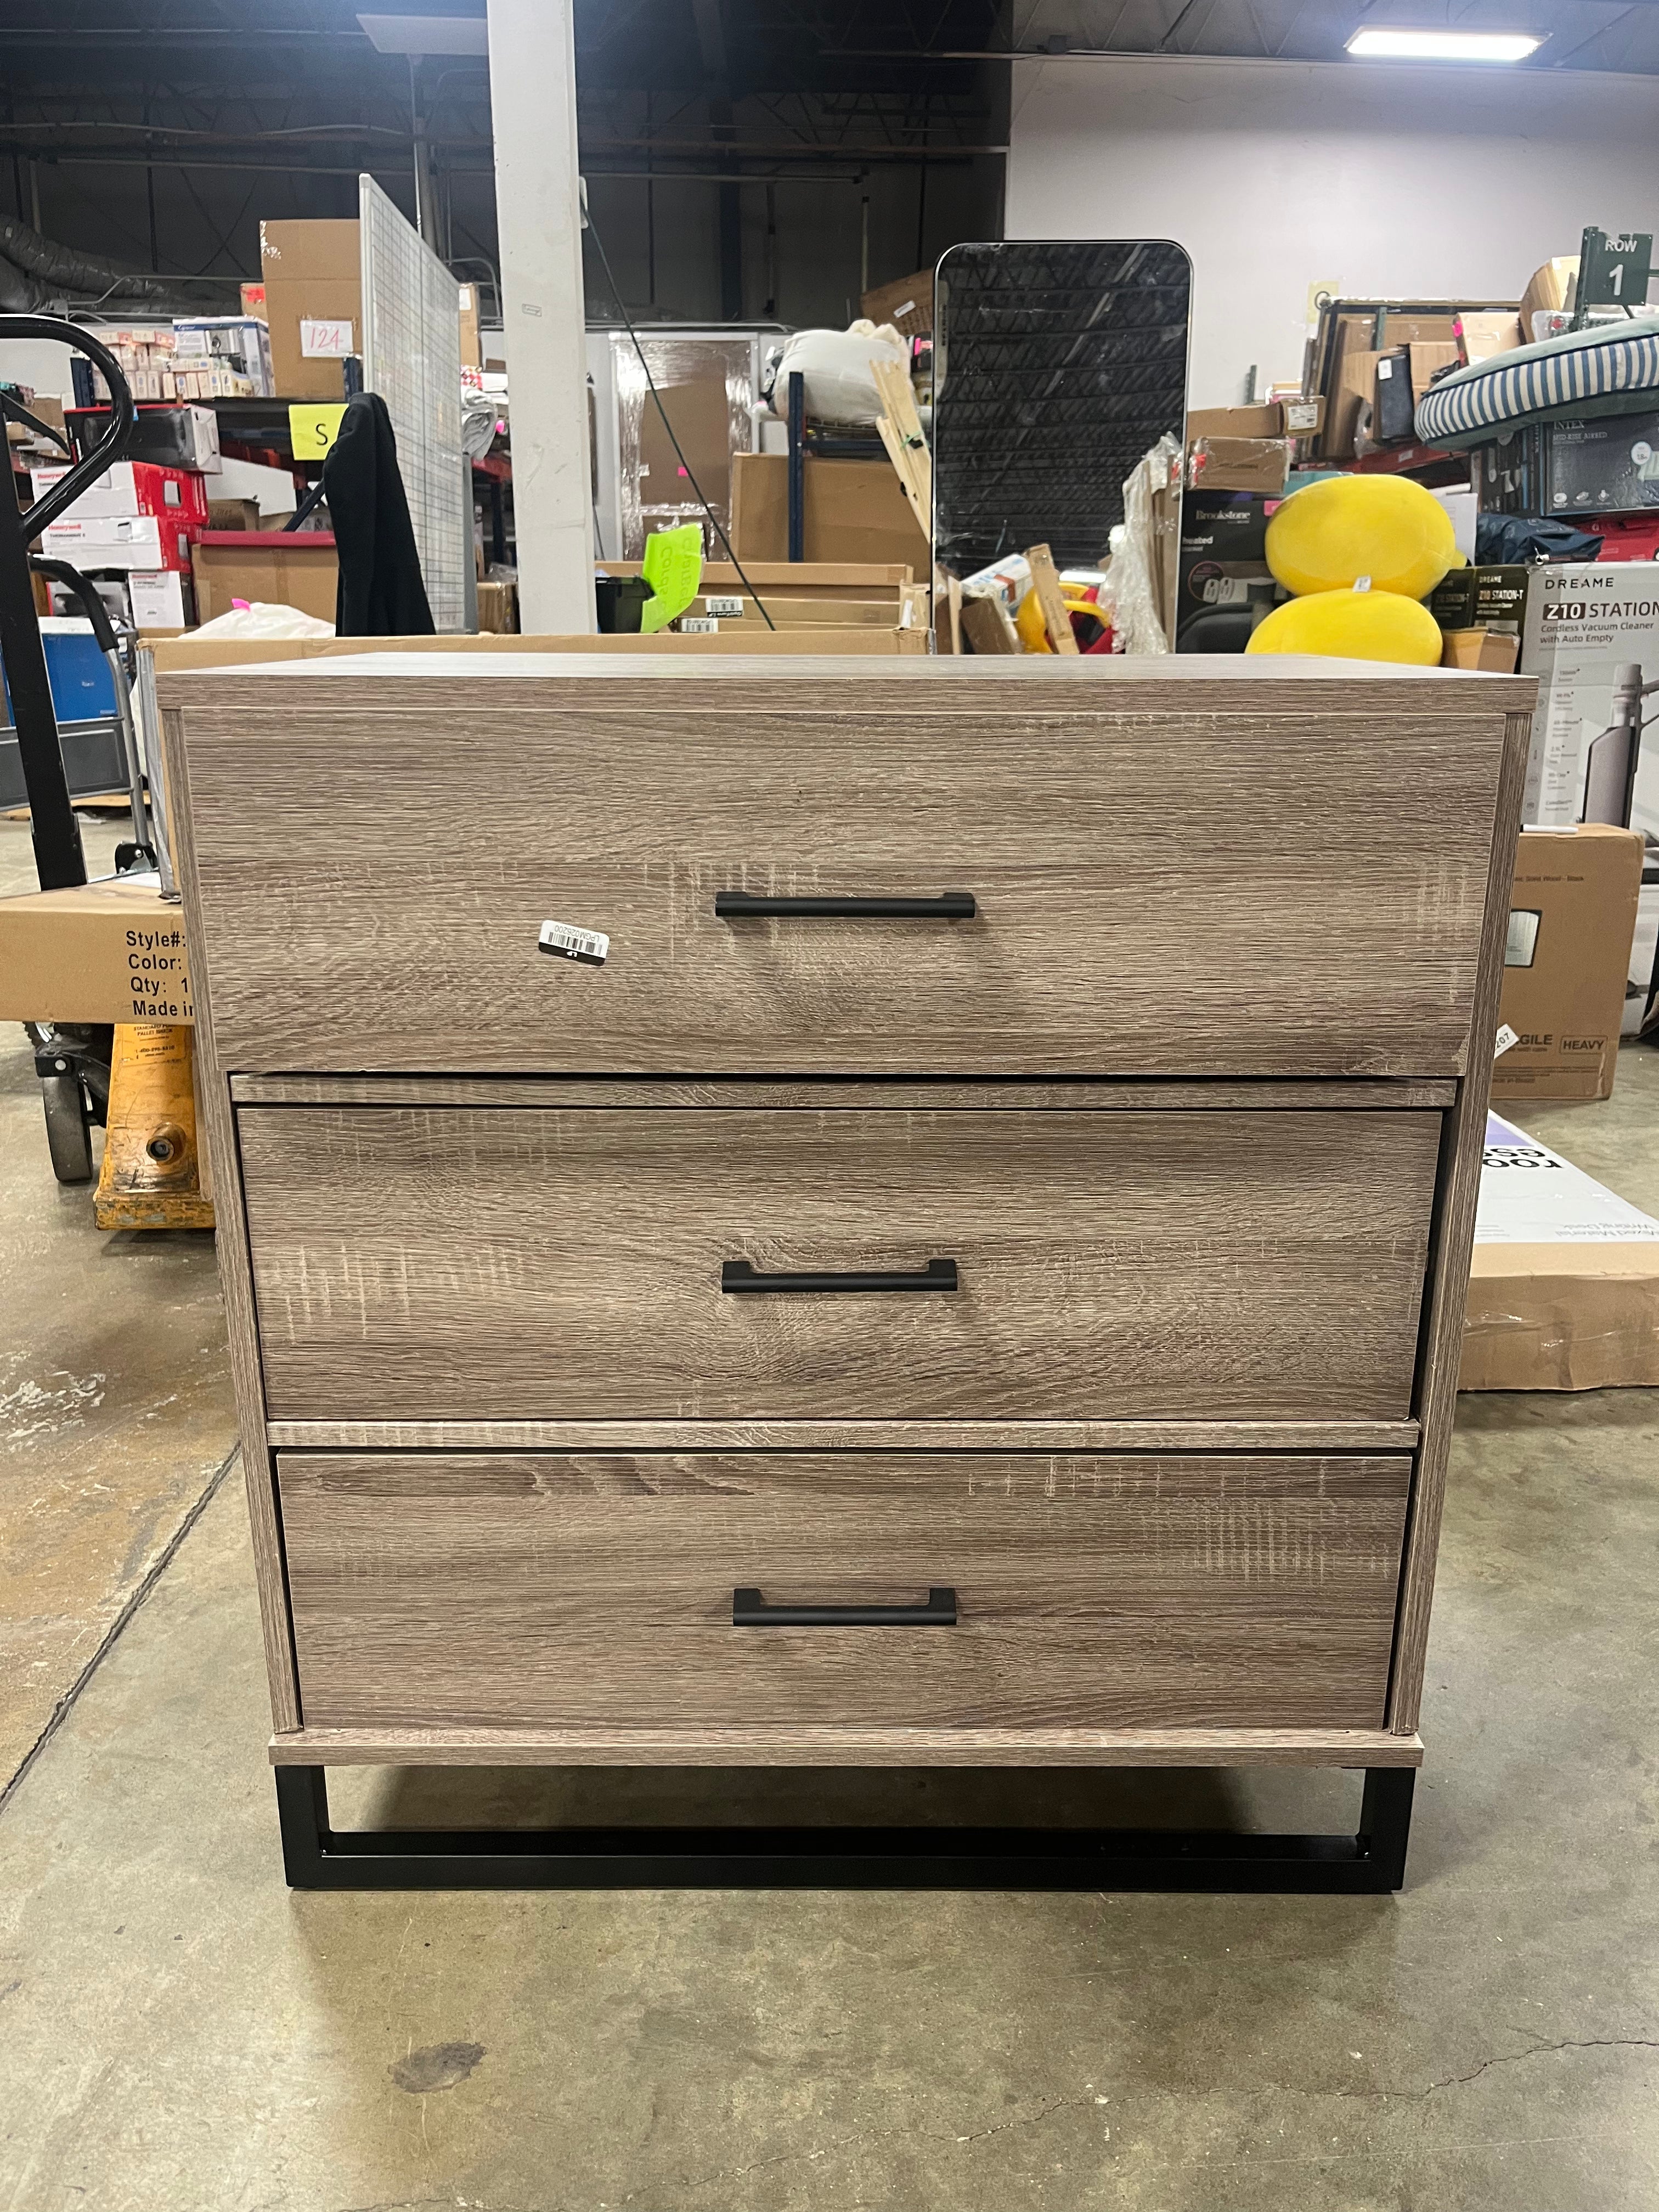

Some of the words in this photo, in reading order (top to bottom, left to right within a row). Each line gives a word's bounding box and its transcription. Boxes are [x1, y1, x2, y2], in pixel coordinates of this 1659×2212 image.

[1605, 240, 1637, 252] ROW
[1609, 264, 1624, 296] 1
[311, 328, 344, 349] 124
[315, 423, 328, 445] S
[1545, 577, 1614, 590] DREAME
[1546, 603, 1582, 620] Z10
[1541, 624, 1579, 633] Cordless
[1581, 621, 1618, 631] Vacuum
[1620, 622, 1654, 630] Cleaner
[1539, 634, 1560, 644] with
[1585, 634, 1614, 643] Empty
[126, 930, 186, 951] Style#:
[128, 953, 182, 970] Color:
[131, 976, 166, 997] Qty:
[181, 977, 188, 993] 1
[133, 1000, 178, 1017] Made
[1563, 1040, 1605, 1050] HEAVY
